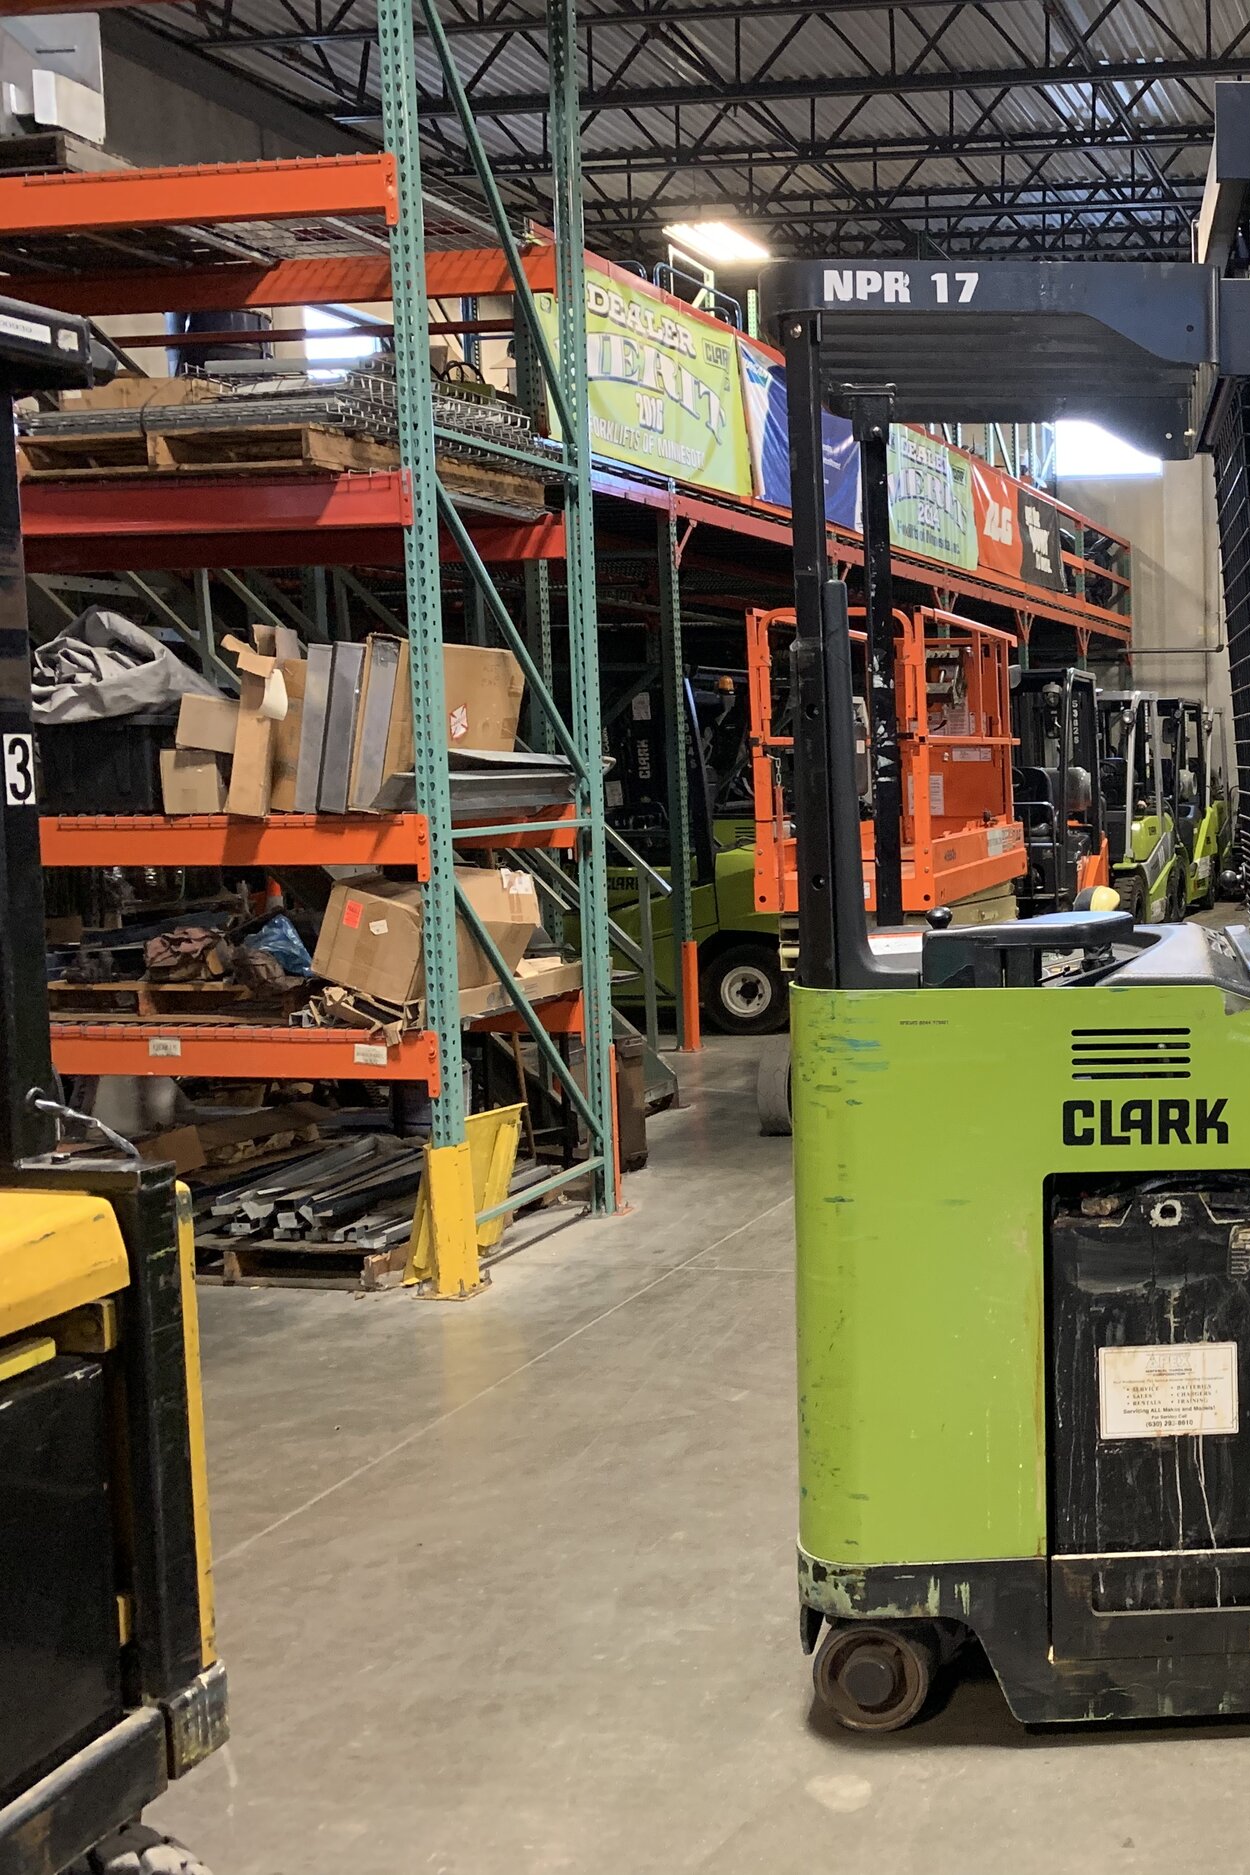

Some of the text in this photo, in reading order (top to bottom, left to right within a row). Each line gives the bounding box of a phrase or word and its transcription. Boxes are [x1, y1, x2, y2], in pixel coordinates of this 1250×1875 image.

[823, 269, 980, 303] NPR 17
[586, 282, 696, 359] DEALER
[8, 737, 33, 801] 3
[1062, 1098, 1230, 1146] CLARK
